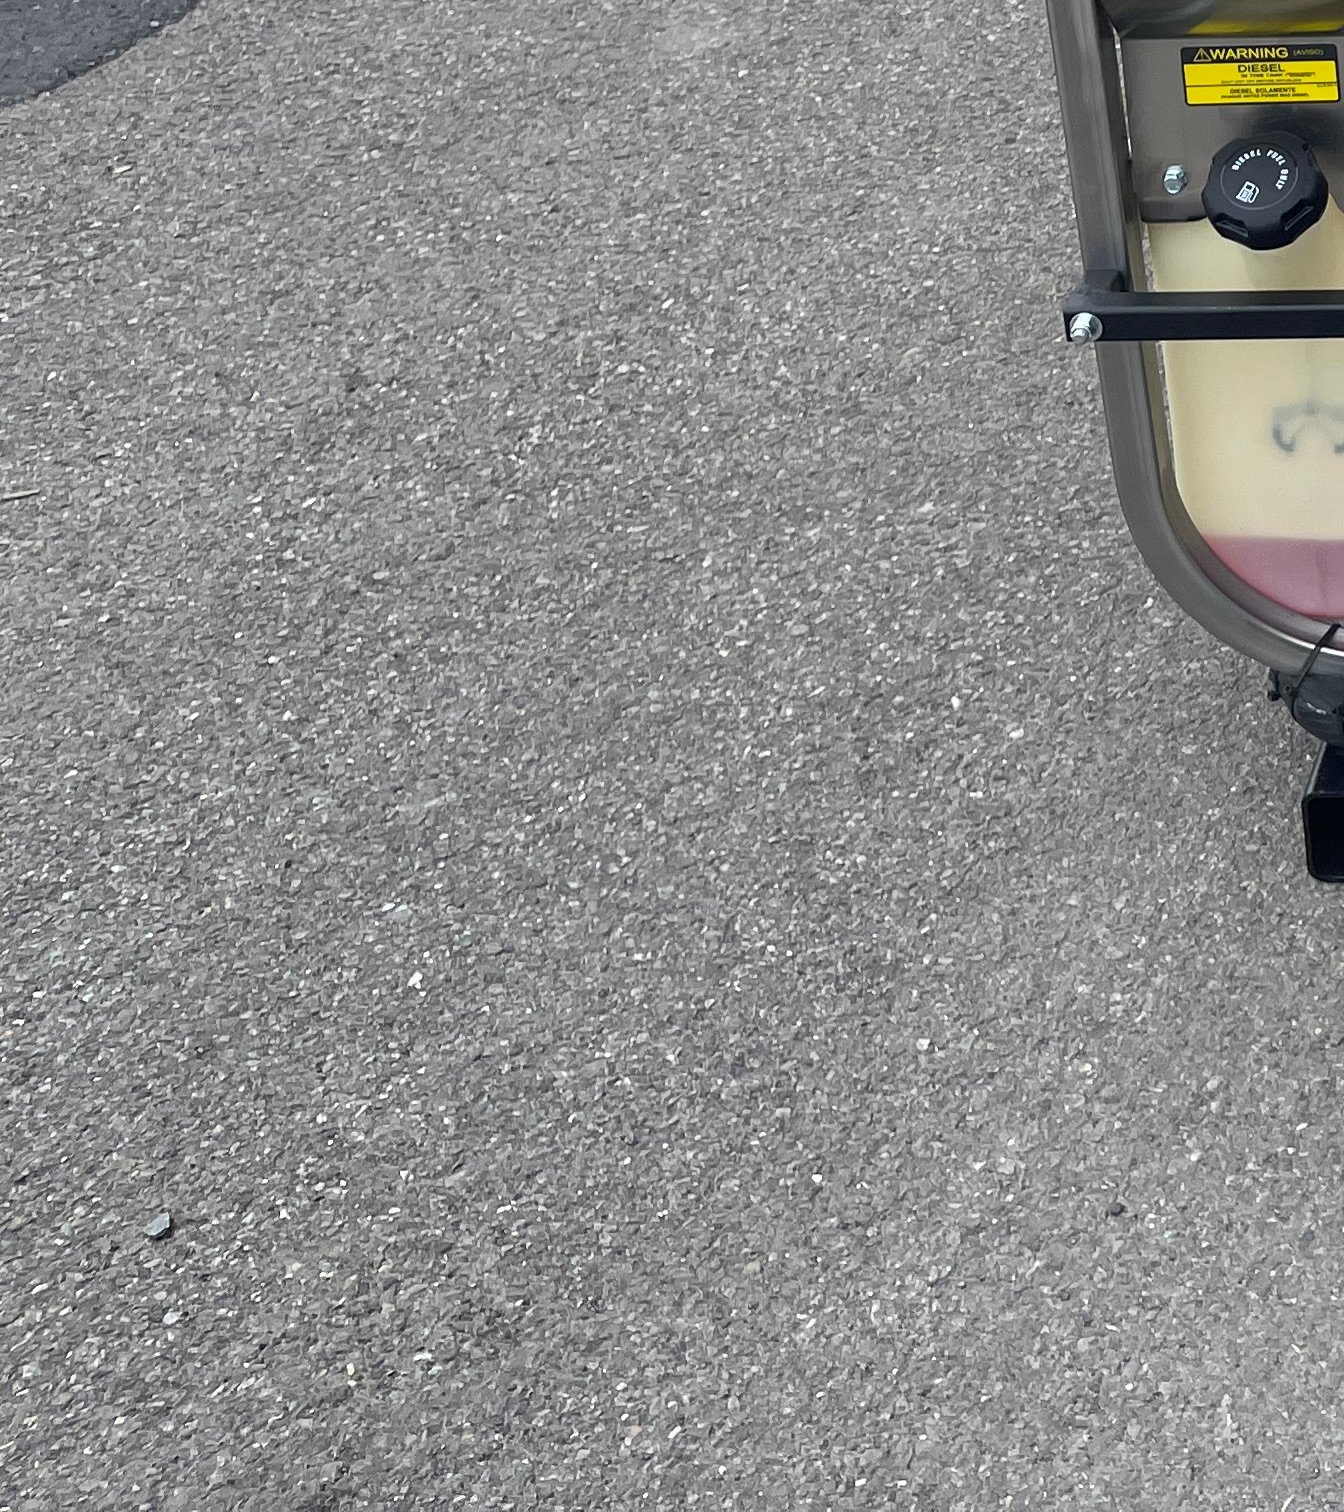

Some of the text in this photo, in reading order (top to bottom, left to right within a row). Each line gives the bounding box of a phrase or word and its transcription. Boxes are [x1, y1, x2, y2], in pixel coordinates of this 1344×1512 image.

[1209, 47, 1289, 60] WARNING
[1237, 64, 1286, 73] DIESEL
[1231, 148, 1262, 171] DIESEL
[1266, 149, 1286, 166] FUEL
